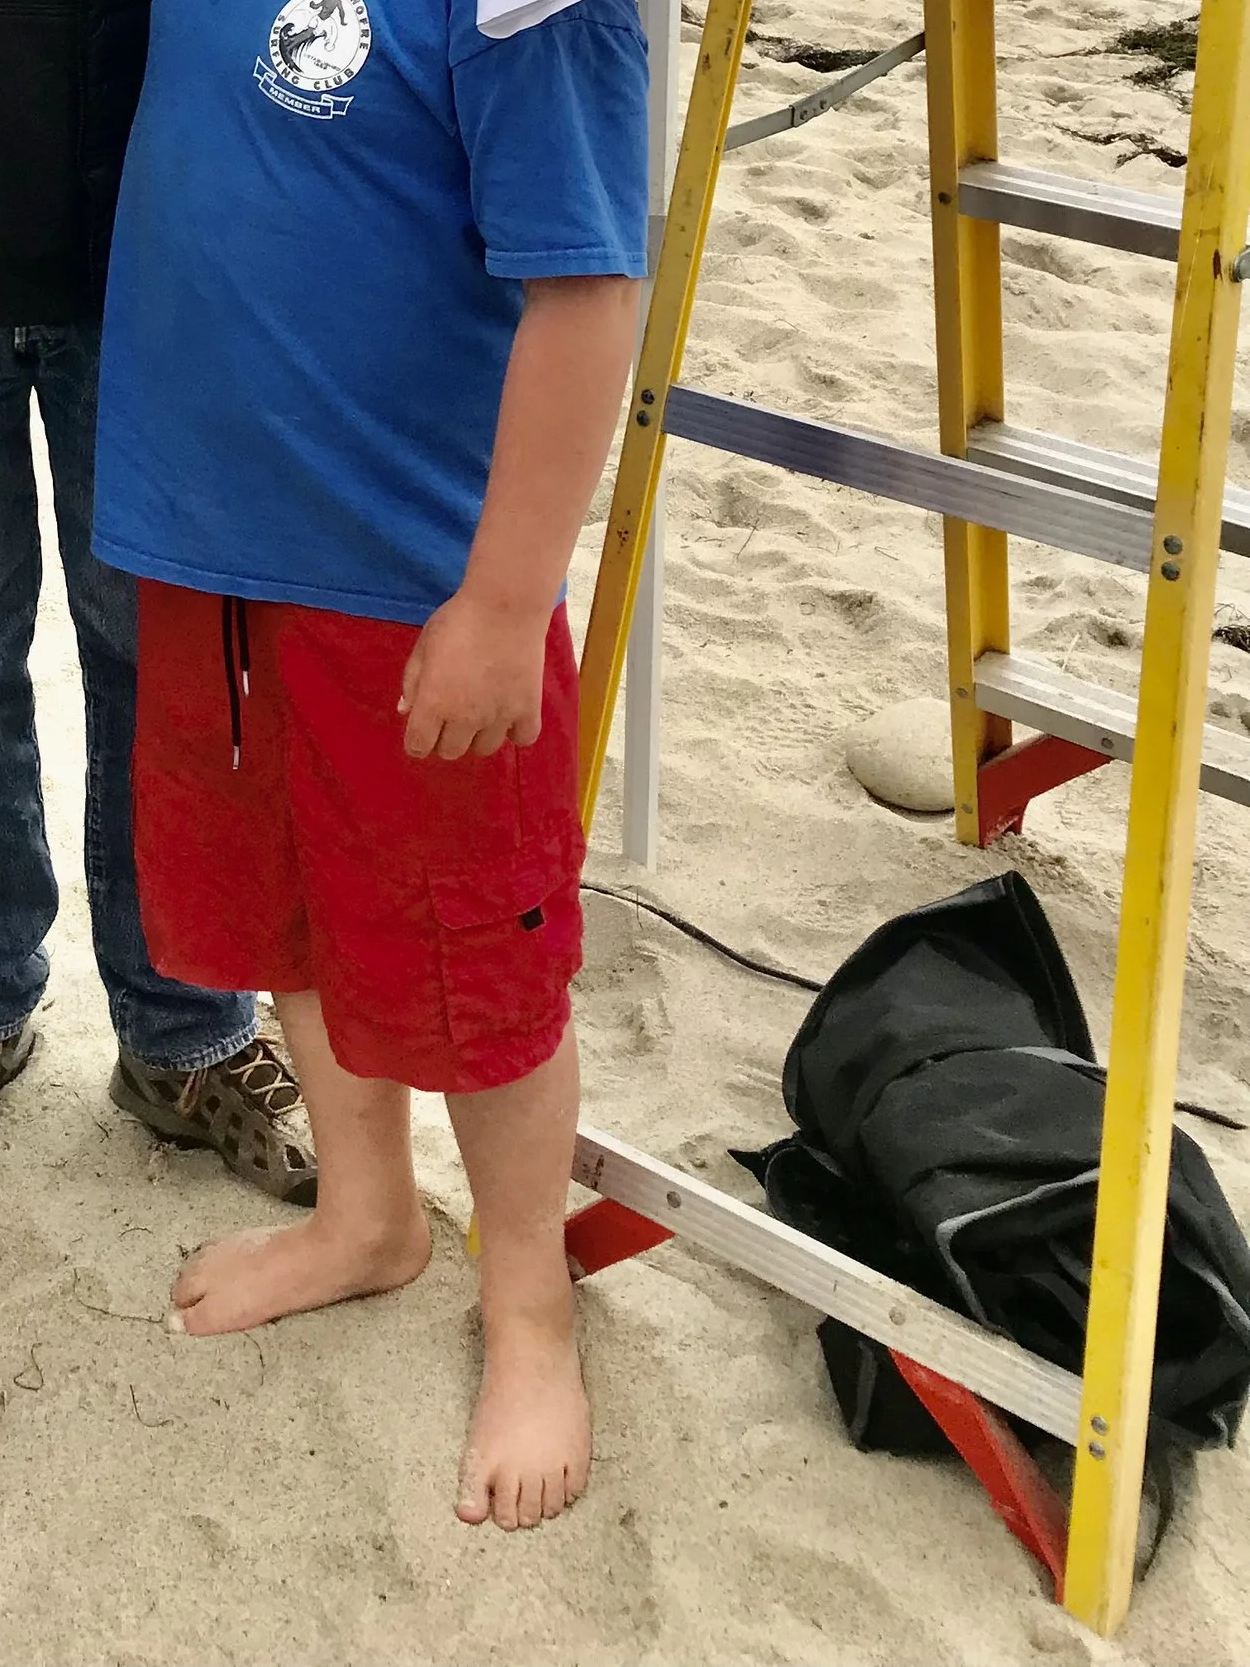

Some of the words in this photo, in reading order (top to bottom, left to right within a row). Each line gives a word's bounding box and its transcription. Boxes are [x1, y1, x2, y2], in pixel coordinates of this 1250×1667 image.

[269, 15, 300, 85] SURFING
[312, 69, 355, 91] CLUB
[268, 86, 321, 114] MEMBER
